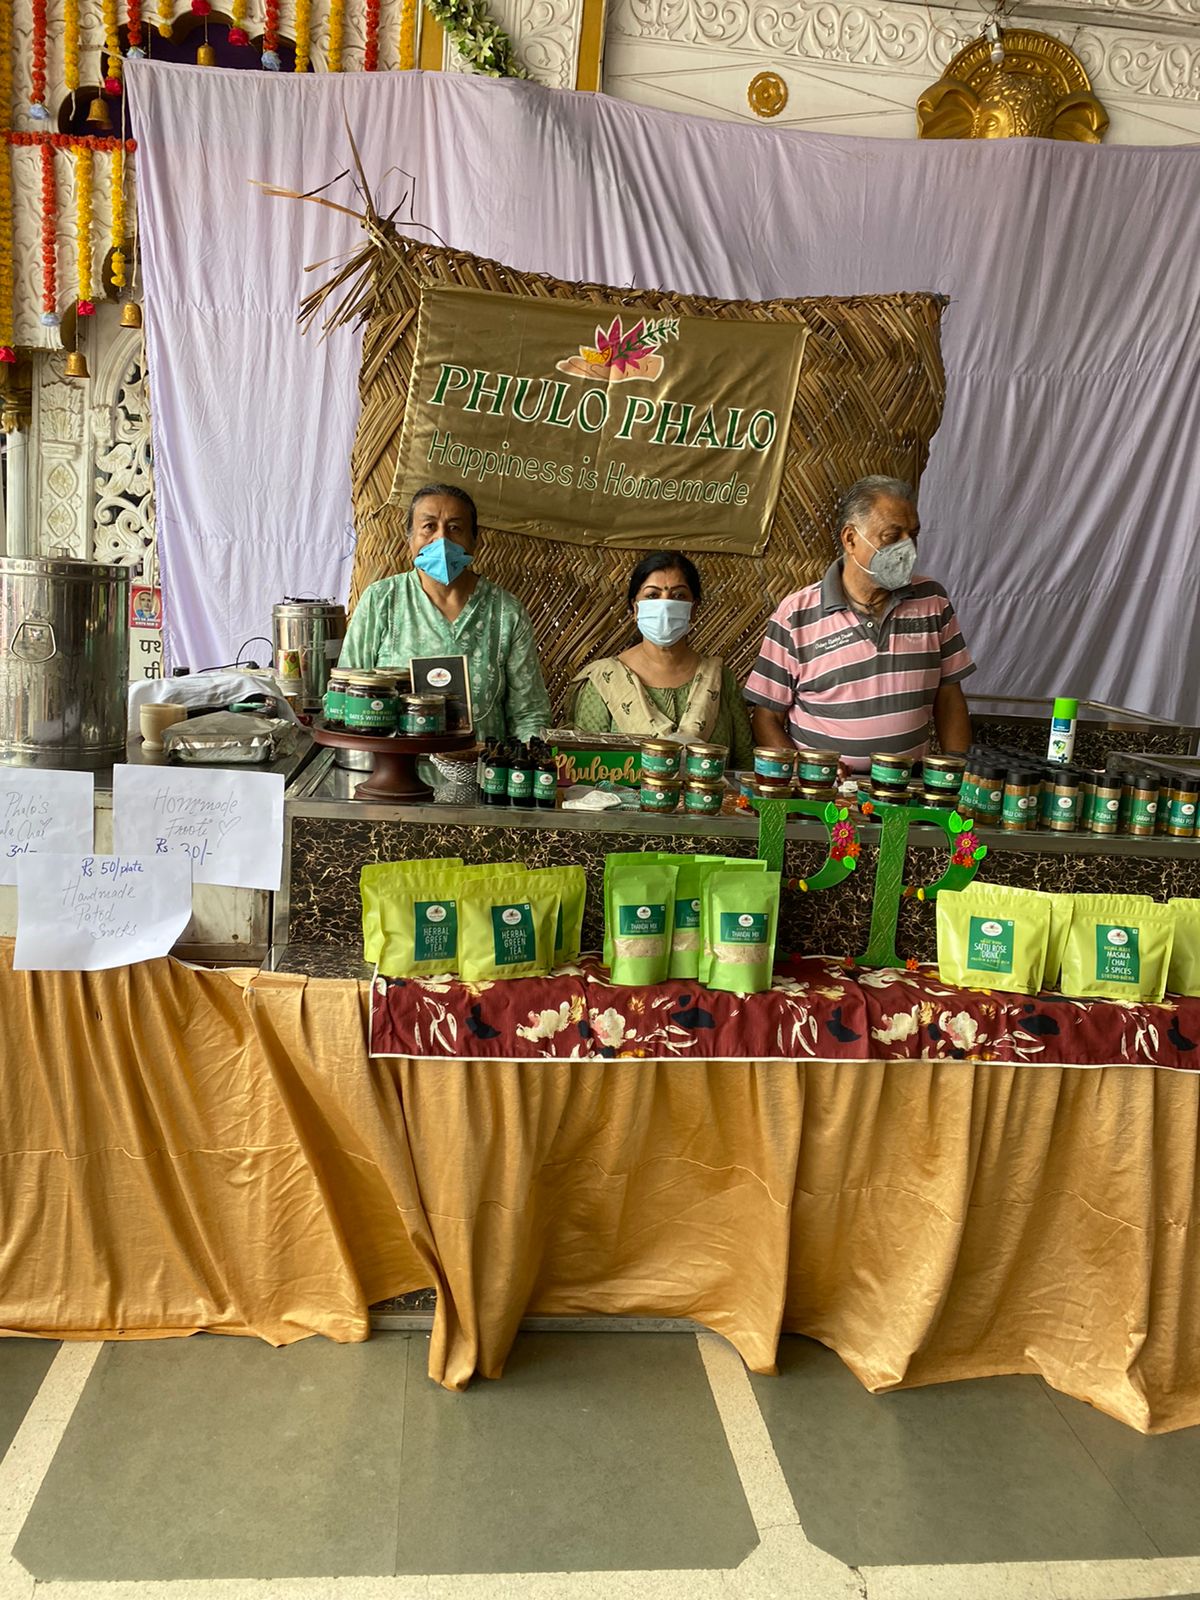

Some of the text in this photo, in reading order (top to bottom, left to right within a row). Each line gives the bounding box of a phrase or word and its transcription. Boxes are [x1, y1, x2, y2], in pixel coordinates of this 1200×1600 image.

[427, 363, 777, 451] PHULO PHALO
[427, 429, 749, 505] Happiness is Homemade
[555, 753, 645, 784] Phulopha
[423, 926, 449, 936] HERBAL
[501, 929, 528, 939] HERBAL
[425, 935, 448, 945] GREEN
[504, 938, 527, 948] GREEN
[430, 943, 444, 952] TEA
[510, 946, 522, 955] TEA
[1107, 951, 1131, 959] MASALA
[1111, 966, 1132, 975] SPICES
